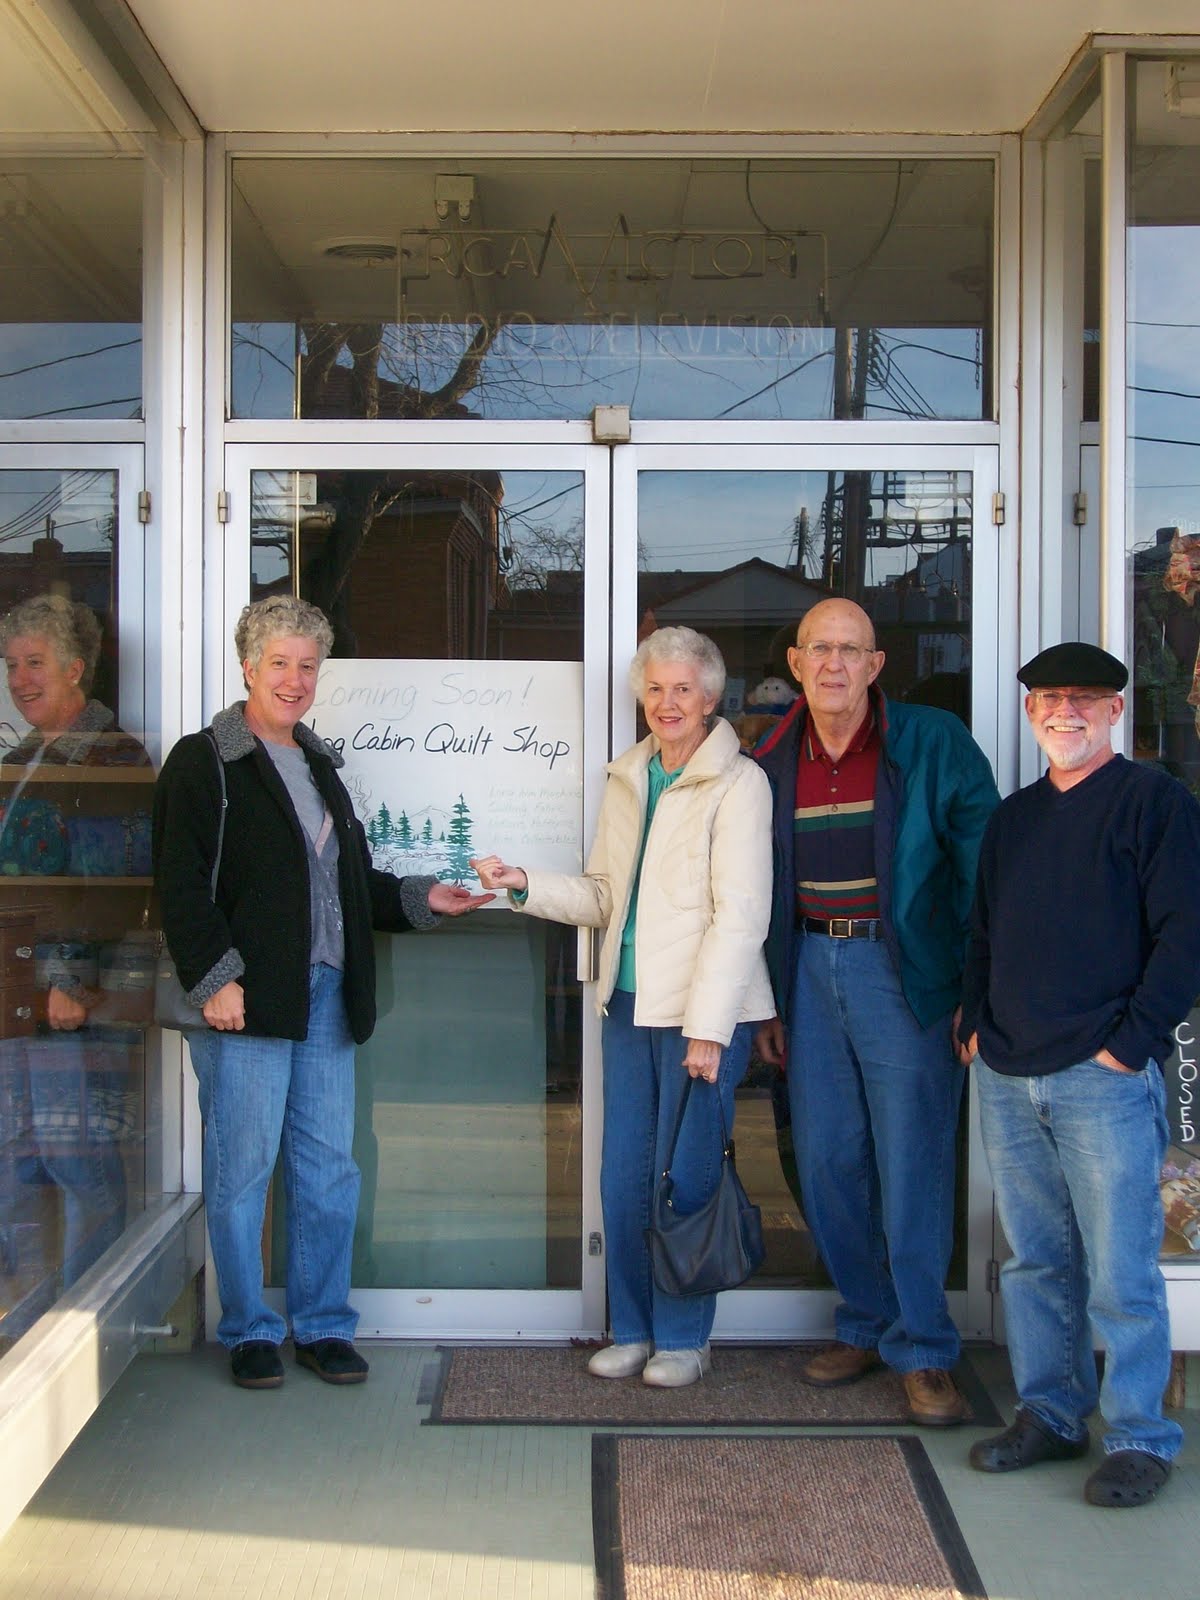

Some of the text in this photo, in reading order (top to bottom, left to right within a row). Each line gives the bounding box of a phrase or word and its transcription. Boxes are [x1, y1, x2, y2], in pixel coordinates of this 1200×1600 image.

[425, 213, 797, 295] RCA VICTOR
[404, 312, 537, 353] RADIO
[583, 312, 824, 353] TELEVISION
[313, 669, 417, 721] Coming
[352, 723, 416, 753] Cabin
[424, 722, 494, 755] Quilt
[503, 725, 571, 770] Shop
[1175, 1022, 1198, 1142] CLOSED
